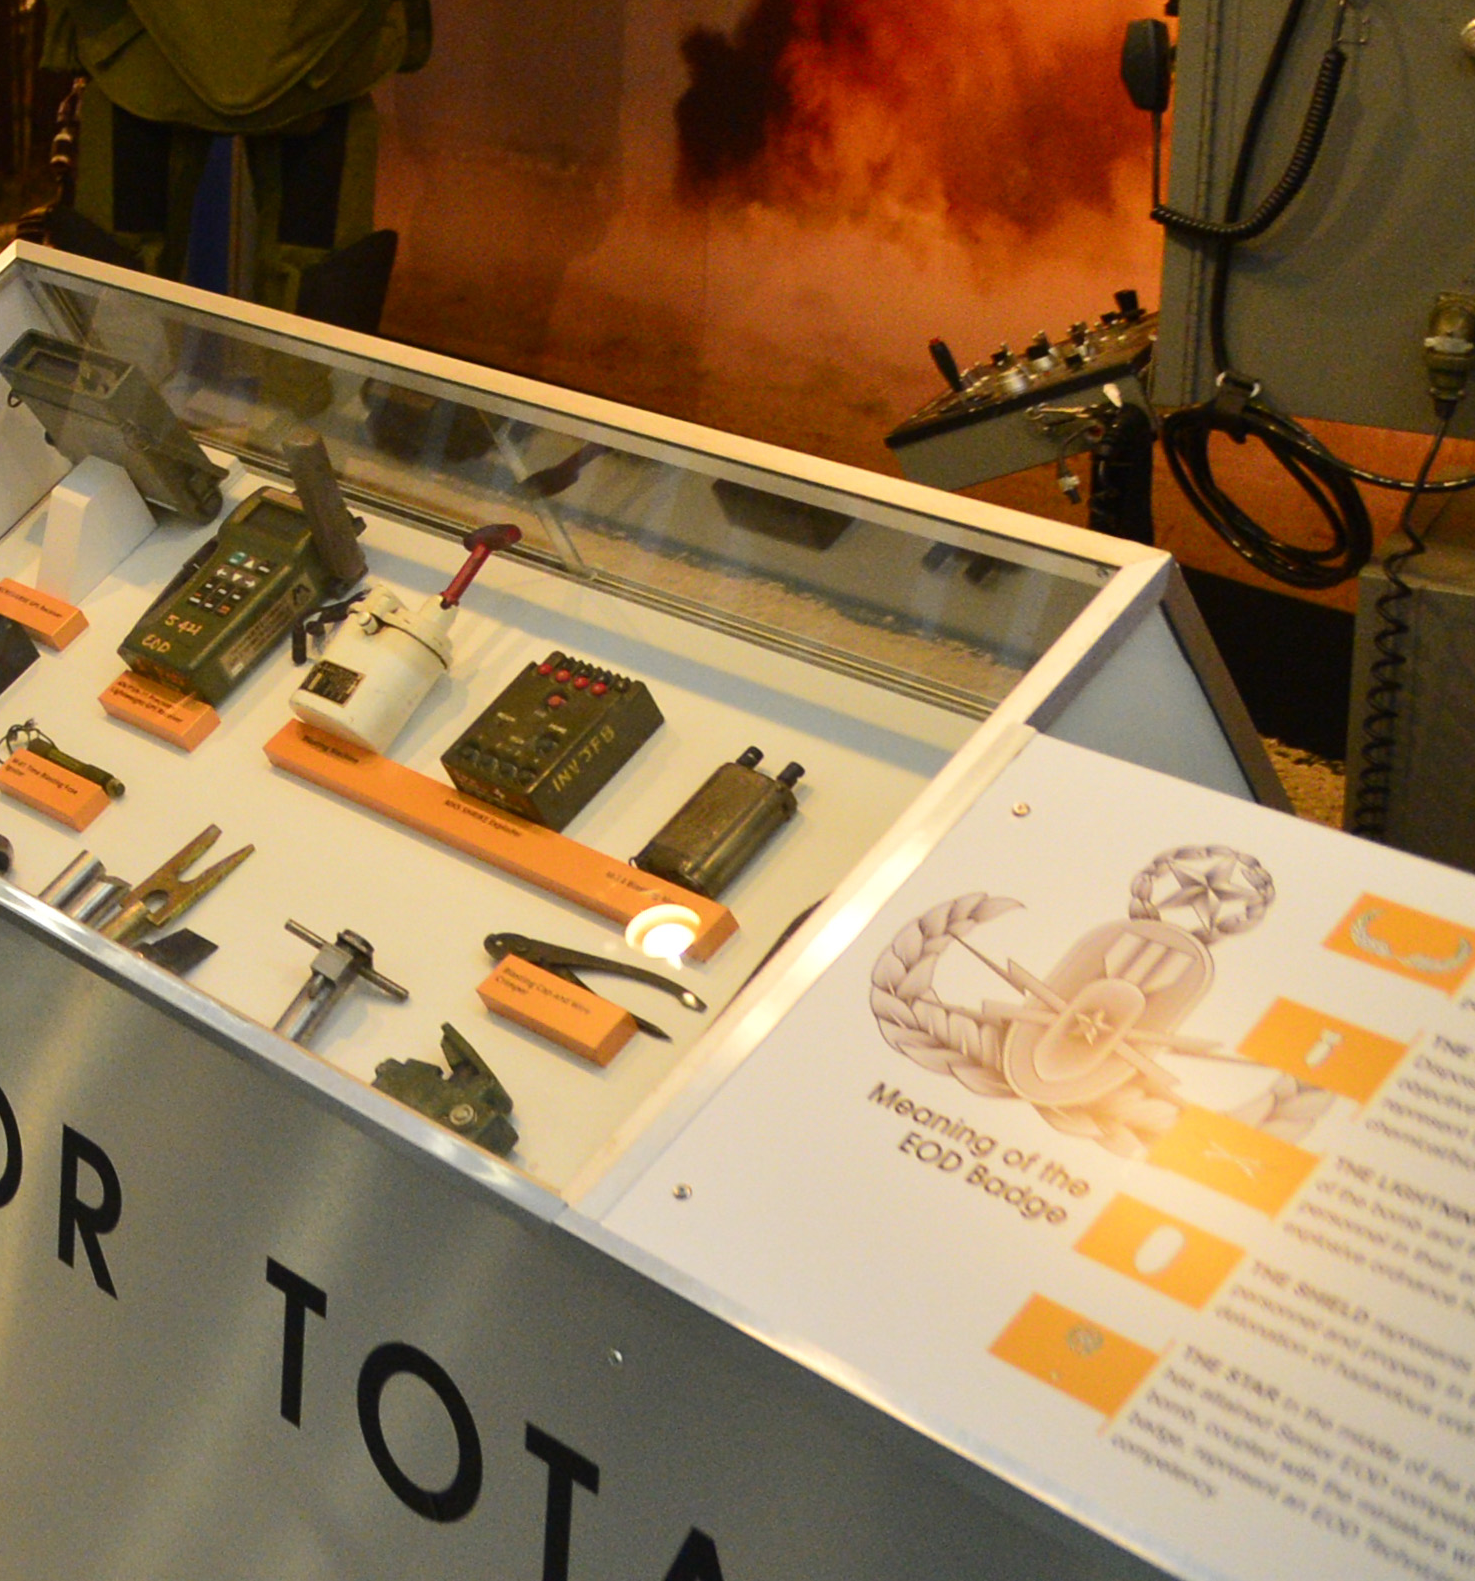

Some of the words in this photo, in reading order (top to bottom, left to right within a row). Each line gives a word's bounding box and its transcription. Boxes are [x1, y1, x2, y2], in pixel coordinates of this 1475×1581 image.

[867, 1081, 998, 1158] Meaning
[1003, 1147, 1040, 1173] of
[1039, 1161, 1090, 1198] the
[898, 1131, 964, 1172] EOD
[965, 1162, 1068, 1225] Badge
[266, 1255, 725, 1581] TOT
